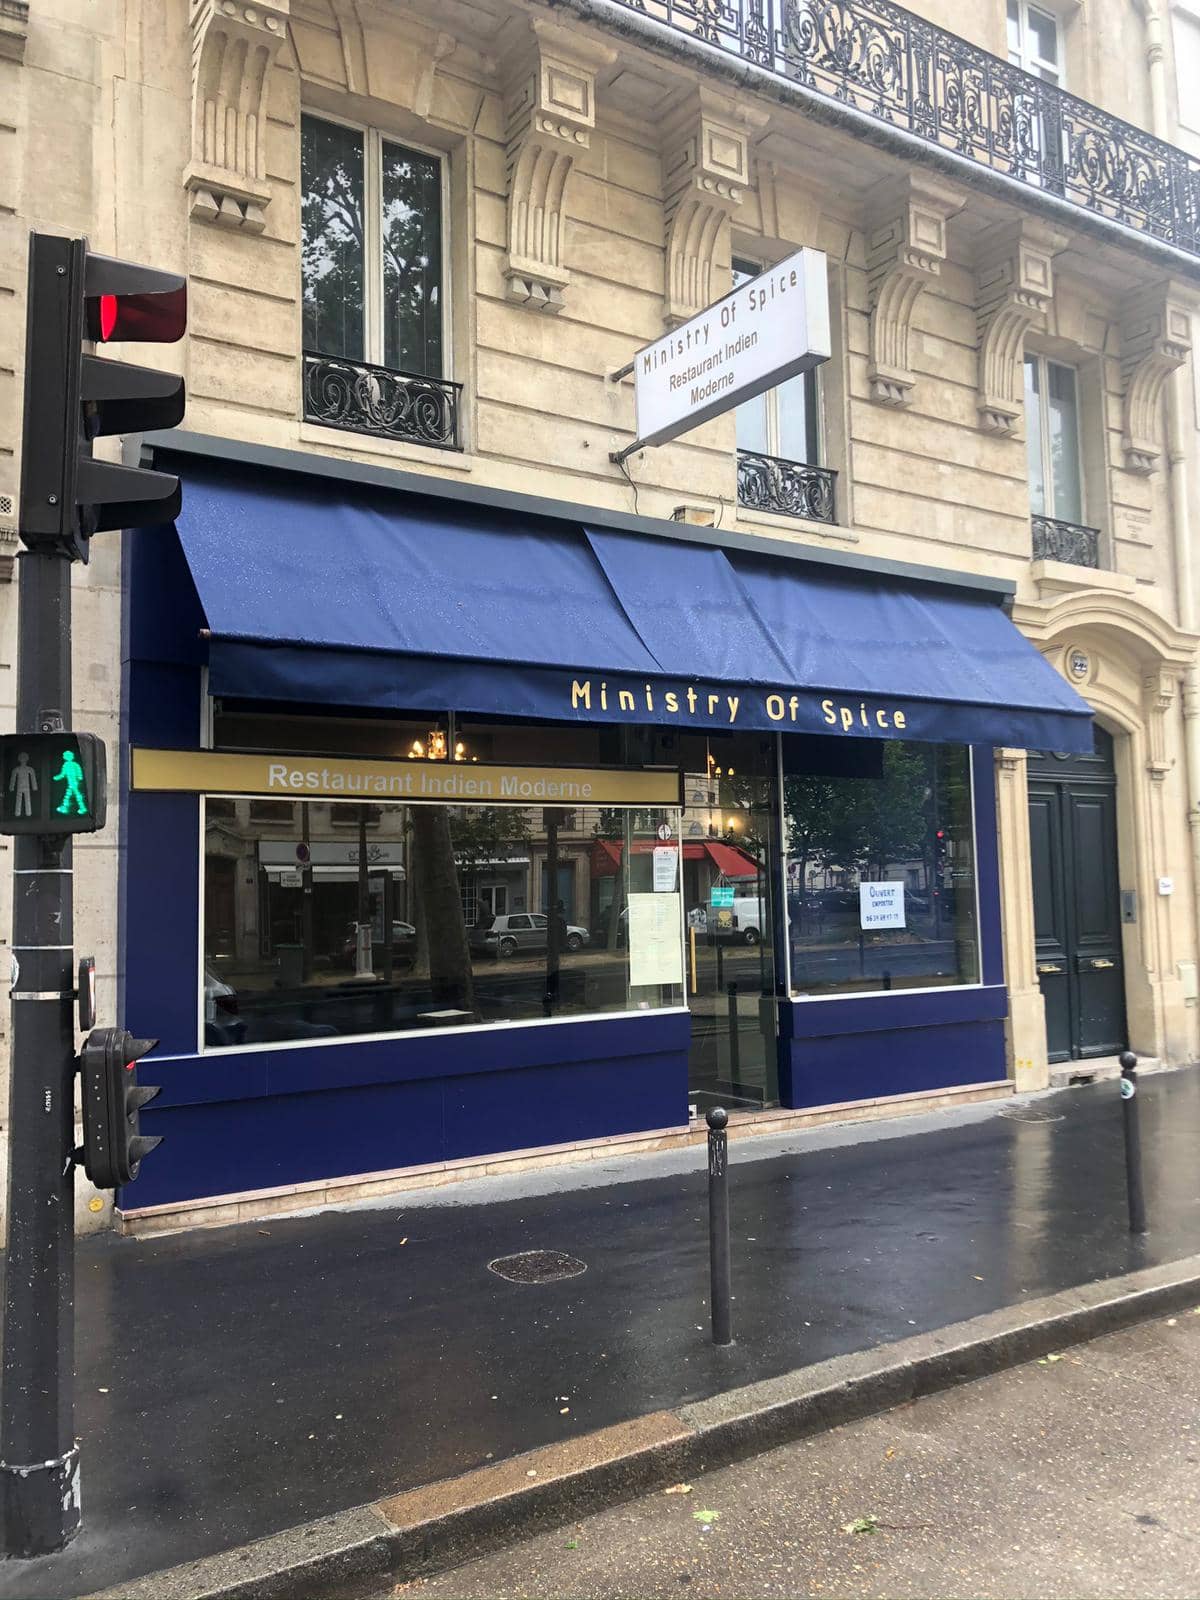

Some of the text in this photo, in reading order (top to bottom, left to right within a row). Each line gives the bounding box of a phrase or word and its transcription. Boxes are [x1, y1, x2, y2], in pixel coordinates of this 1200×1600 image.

[644, 269, 797, 375] Ministry Of Spice
[669, 330, 758, 392] Restaurant Indien
[690, 371, 735, 405] Moderne
[571, 680, 906, 731] Ministry Of Spice
[268, 764, 592, 797] Restaurant Indien Moderne
